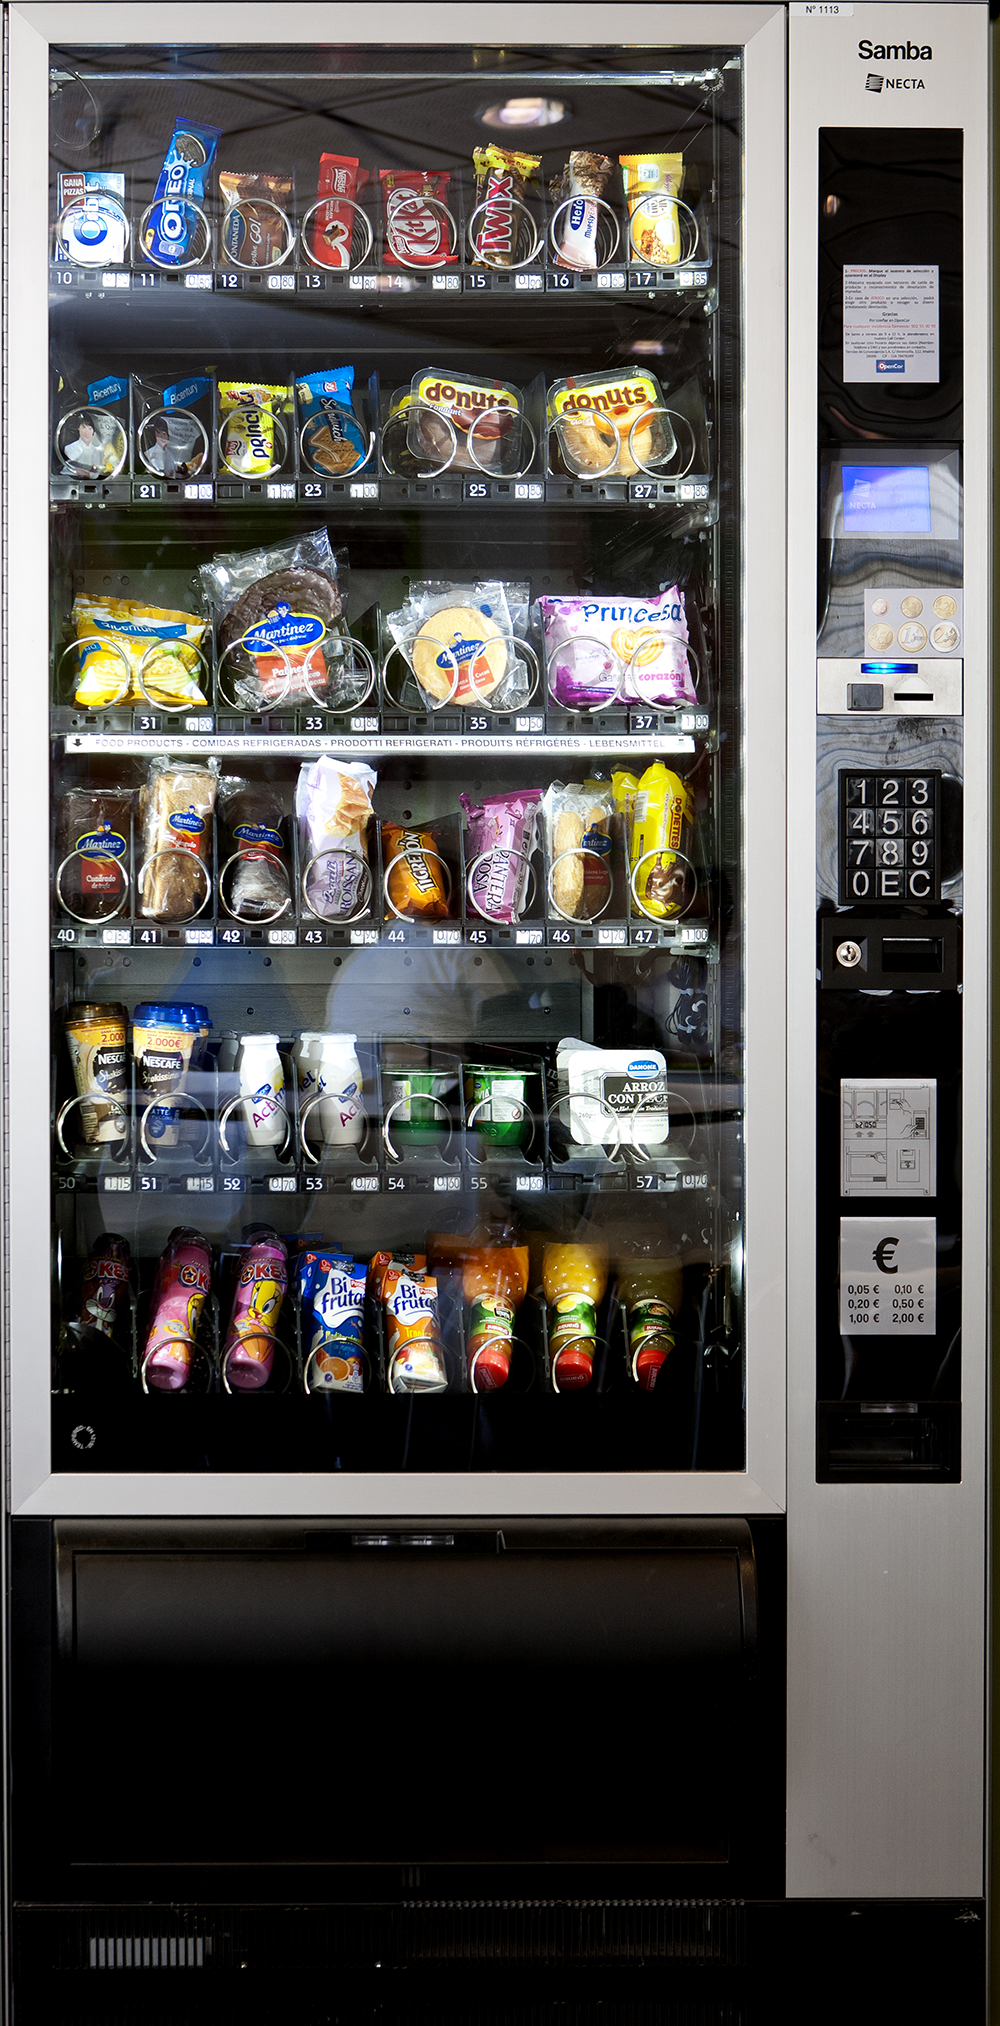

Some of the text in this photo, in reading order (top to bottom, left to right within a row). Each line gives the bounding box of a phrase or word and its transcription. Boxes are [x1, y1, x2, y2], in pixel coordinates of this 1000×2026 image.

[819, 5, 840, 14] 1113
[858, 39, 933, 61] Samba
[886, 78, 926, 90] NECTA
[63, 178, 83, 188] GANA
[63, 187, 85, 196] PIZZAS
[571, 198, 584, 226] Hero
[248, 216, 263, 245] GO!
[229, 214, 241, 262] ONTANEDA
[56, 271, 73, 284] 10
[140, 273, 155, 286] 11
[221, 275, 238, 287] 12
[305, 275, 321, 287] 13
[387, 276, 404, 288] 14
[470, 275, 486, 287] 15
[553, 275, 570, 287] 16
[635, 273, 652, 286] 17
[878, 362, 904, 372] OpenCor
[93, 383, 122, 402] Bicentury
[170, 383, 198, 405] Bicentury
[425, 382, 512, 416] donuts
[562, 386, 648, 416] donuts
[139, 484, 156, 498] 21
[304, 483, 322, 497] 23
[469, 484, 487, 497] 25
[634, 485, 653, 498] 27
[849, 501, 877, 510] NECTA
[581, 603, 683, 624] Princesa
[638, 668, 682, 682] corazón
[140, 717, 157, 730] 31
[305, 717, 323, 730] 33
[470, 716, 488, 730] 35
[635, 716, 653, 729] 37
[95, 737, 666, 748] FOOD PRODUCTS COMIDAS REFRIGERADAS PRODOTTI REFRIGERATI PRODUITS RÉFRIGÉRÉS LEBENSMITTEL
[856, 779, 866, 804] 1
[882, 779, 899, 804] 2
[911, 779, 928, 805] 3
[670, 794, 684, 850] DONETTES
[852, 810, 869, 835] 4
[882, 810, 899, 835] 5
[911, 810, 928, 835] 6
[852, 840, 869, 865] 7
[881, 840, 899, 866] 8
[911, 840, 928, 866] 9
[86, 874, 117, 883] Cuadrado
[852, 870, 869, 897] 0
[881, 870, 900, 896] E
[909, 870, 931, 897] C
[57, 929, 75, 942] 40
[140, 930, 157, 943] 41
[222, 931, 241, 943] 42
[305, 931, 323, 943] 43
[388, 930, 406, 942] 44
[469, 930, 488, 943] 45
[552, 930, 570, 943] 46
[635, 930, 653, 943] 47
[147, 1036, 182, 1049] 2.000€
[142, 1055, 182, 1069] NESCAFÉ
[629, 1063, 657, 1072] DANONE
[622, 1082, 667, 1093] ARROZ
[608, 1094, 631, 1104] CON
[58, 1177, 75, 1189] 50
[141, 1177, 157, 1190] 51
[223, 1178, 241, 1190] 52
[305, 1178, 323, 1190] 53
[388, 1178, 405, 1190] 54
[471, 1178, 488, 1190] 55
[636, 1176, 654, 1189] 57
[872, 1236, 900, 1274] €
[331, 1275, 348, 1295] Bi
[401, 1283, 417, 1299] Bi
[847, 1284, 880, 1295] 0,05 €
[894, 1284, 924, 1295] 0,10 €
[847, 1299, 880, 1309] 0,20 €
[892, 1299, 924, 1309] 0,50 €
[849, 1313, 880, 1324] 1,00 €
[892, 1313, 924, 1324] 2,00 €
[557, 1322, 581, 1332] granini
